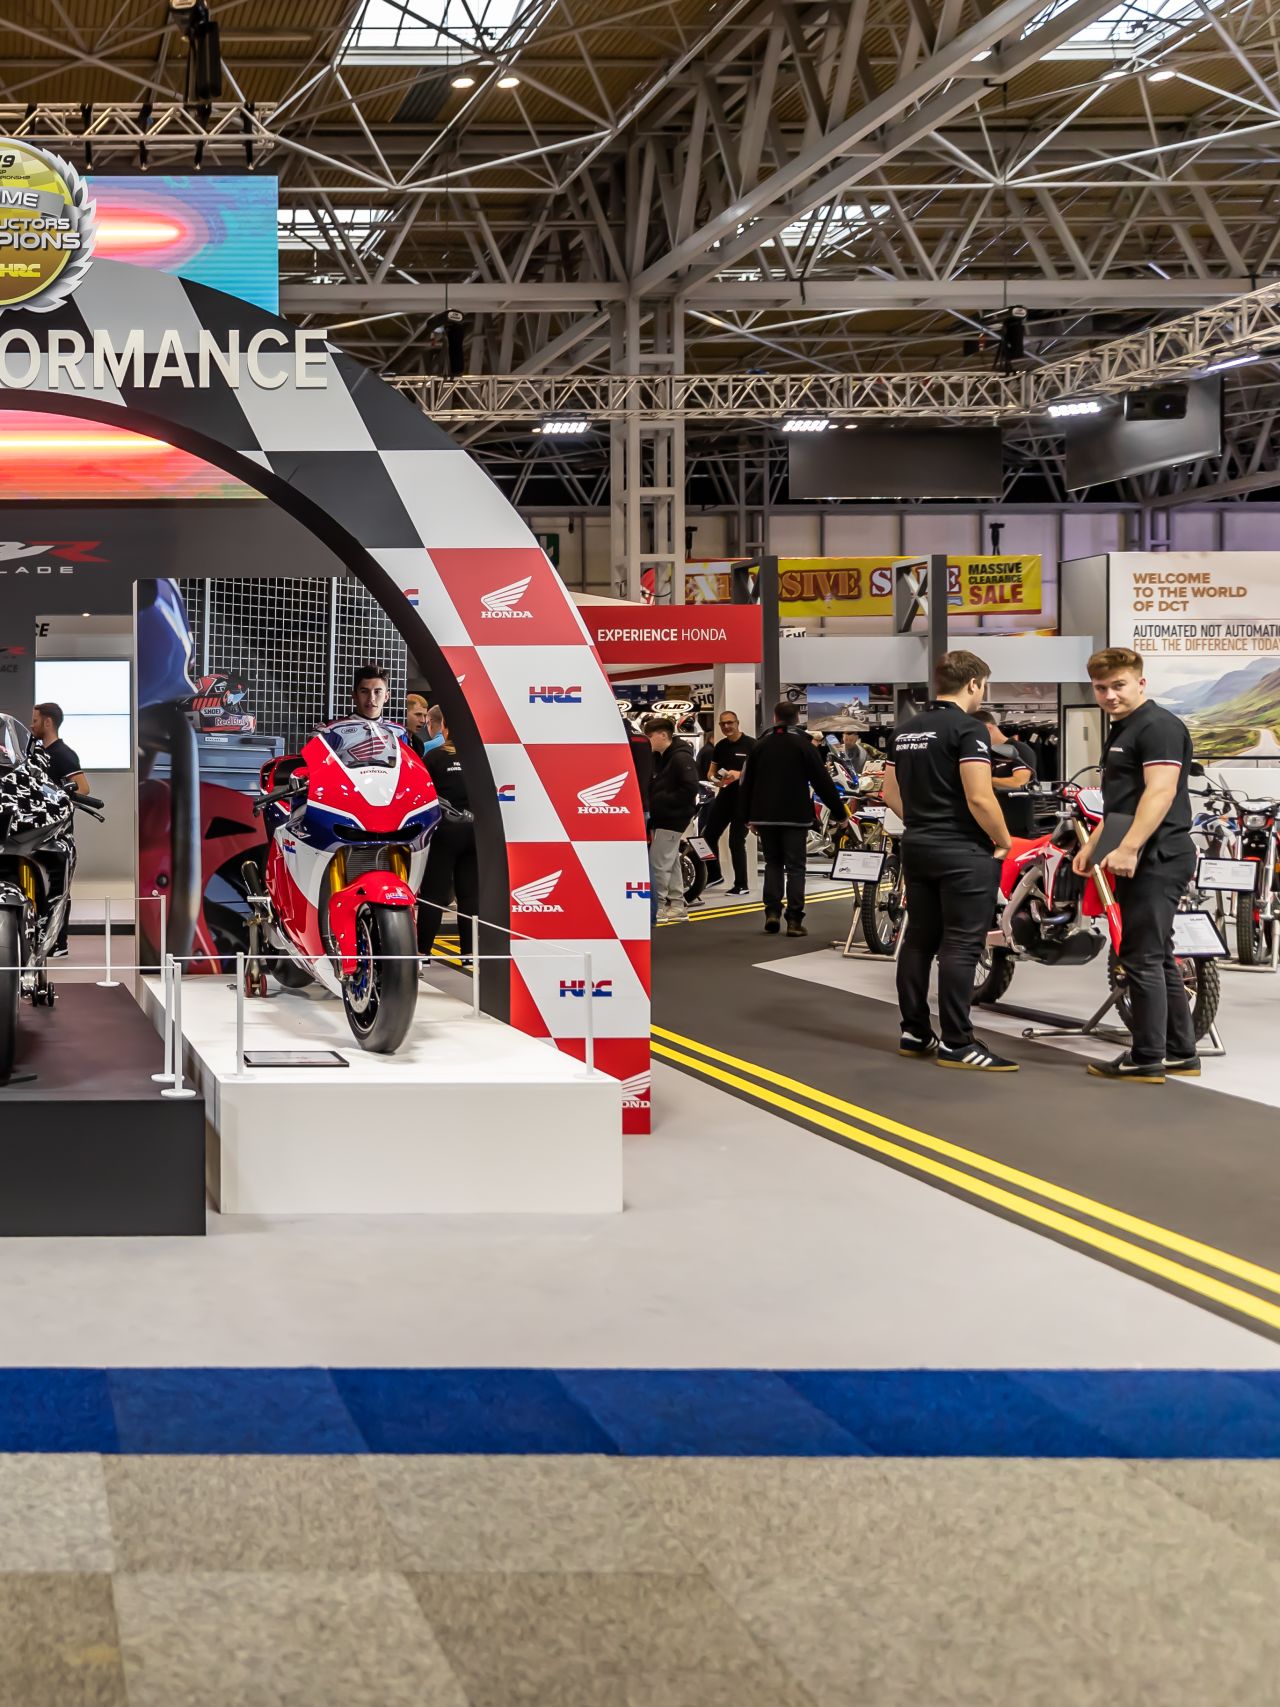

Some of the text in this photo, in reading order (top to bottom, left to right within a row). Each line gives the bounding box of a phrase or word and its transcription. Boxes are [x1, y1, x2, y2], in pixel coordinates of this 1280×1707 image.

[0, 263, 41, 278] HRC
[968, 562, 1022, 575] MASSIVE
[968, 575, 1023, 585] CLEARANCE
[1133, 573, 1210, 584] WELCOME
[969, 584, 1024, 605] SALE
[1133, 586, 1247, 598] TO THE WORLD
[1133, 600, 1189, 612] OF DCT
[597, 628, 727, 641] EXPERIENCE HONDA
[1133, 624, 1197, 637] AUTOMATED
[1201, 624, 1222, 637] NOT
[1134, 638, 1280, 651] FEEL THE DIFFERENCE TODA
[529, 686, 582, 703] HRC
[658, 703, 687, 711] HJC
[577, 806, 631, 814] HONDA
[511, 904, 564, 912] HONDA
